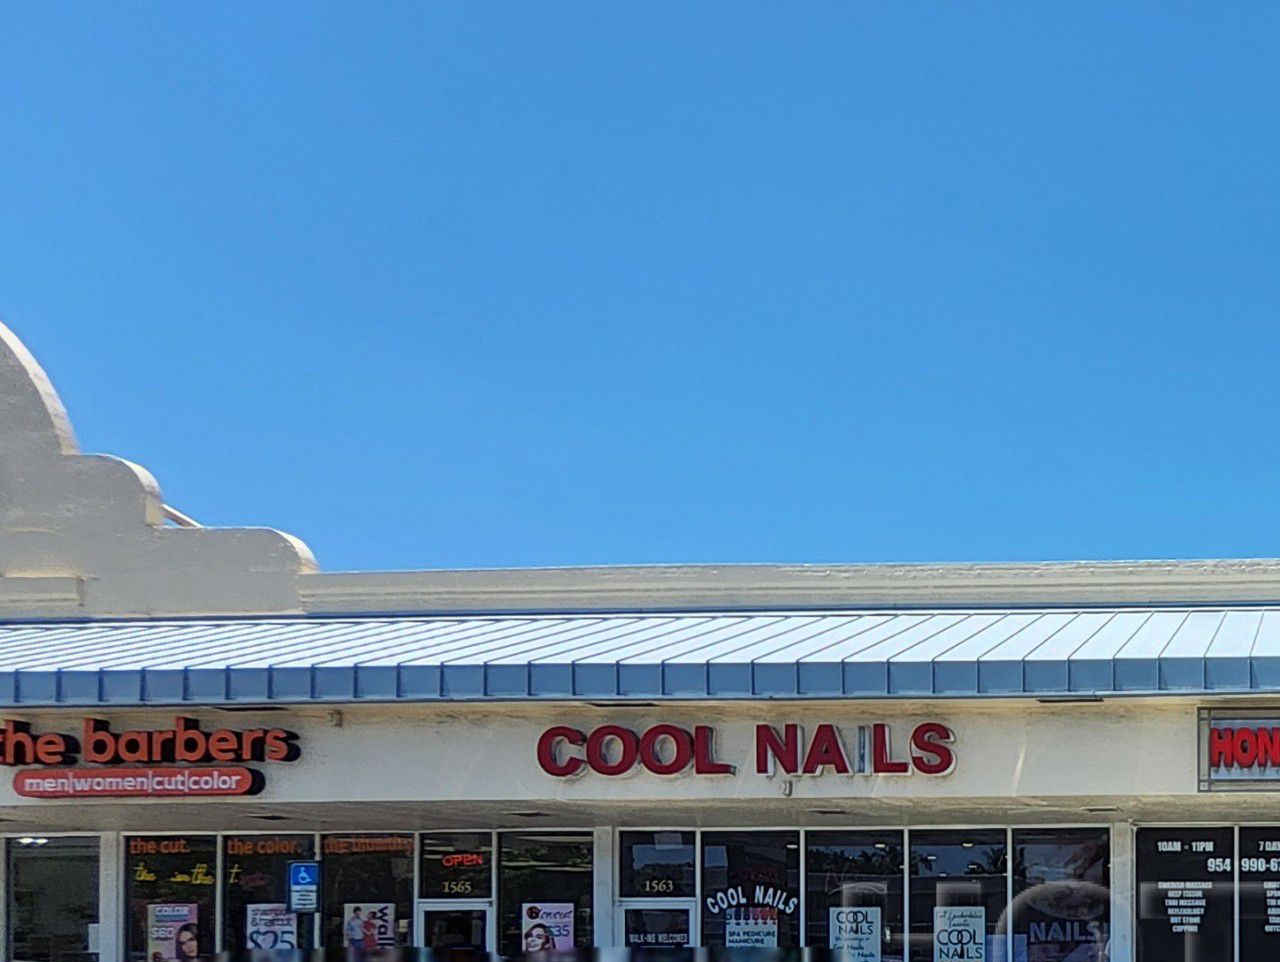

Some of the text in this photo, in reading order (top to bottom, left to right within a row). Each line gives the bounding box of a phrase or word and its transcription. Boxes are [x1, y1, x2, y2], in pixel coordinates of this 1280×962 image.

[82, 716, 290, 762] barbers
[536, 722, 957, 778] COOL NAILS
[1157, 841, 1182, 852] 10AM
[1191, 841, 1214, 852] 11PM
[1258, 841, 1265, 851] 7
[442, 853, 484, 867] OPEN
[1207, 858, 1232, 872] 954
[442, 880, 472, 894] 1565
[644, 879, 674, 893] 1563
[706, 885, 798, 914] COOL NAILS
[836, 910, 874, 924] COOL
[838, 924, 874, 936] NAILS
[936, 928, 984, 946] COOL
[938, 947, 983, 960] NAILS
